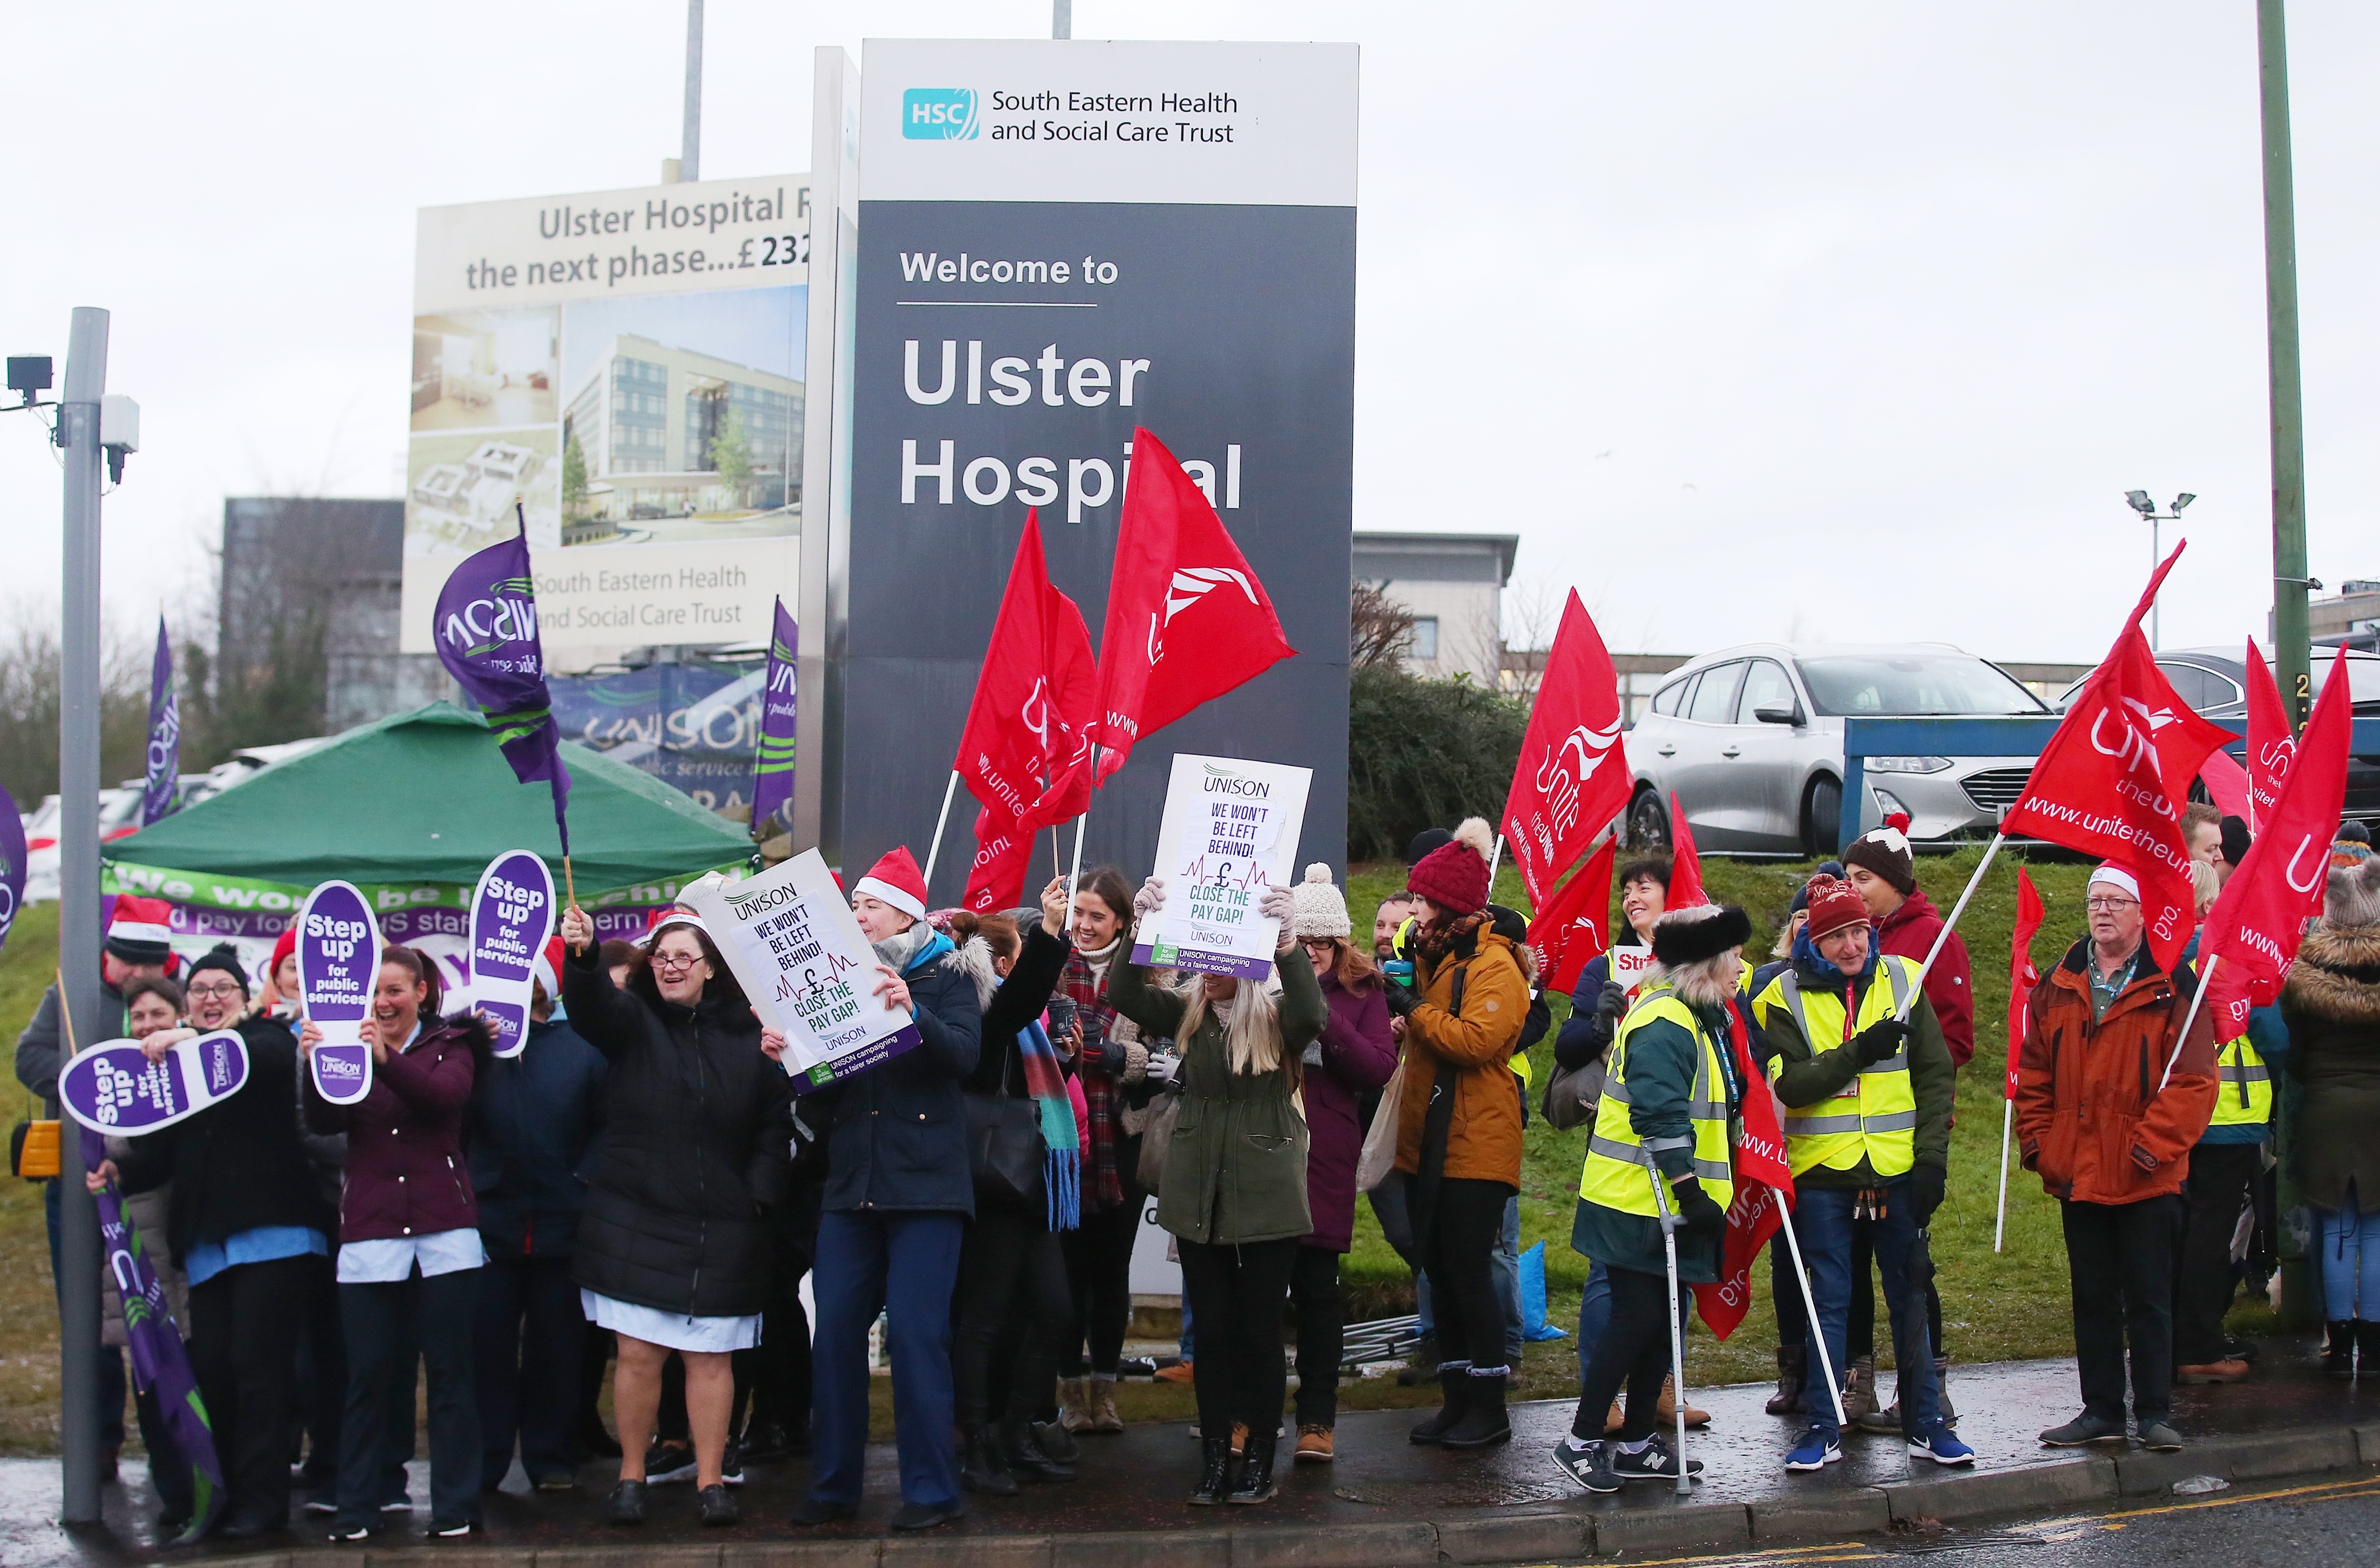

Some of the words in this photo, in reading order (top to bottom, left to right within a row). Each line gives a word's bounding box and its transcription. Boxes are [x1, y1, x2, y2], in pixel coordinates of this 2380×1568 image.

[912, 103, 964, 124] HSC
[992, 91, 1060, 111] South
[1068, 92, 1152, 112] Eastern
[1161, 93, 1238, 113] Health
[992, 120, 1036, 140] and
[1043, 121, 1108, 141] Social
[1116, 122, 1168, 142] Care
[1176, 122, 1234, 143] Trust
[539, 206, 634, 239] Ulster
[646, 187, 784, 234] Hospital
[467, 257, 518, 290] the
[527, 253, 598, 285] next
[899, 252, 1071, 284] Welcome
[1082, 254, 1119, 284] to
[902, 339, 1151, 407] Ulster
[900, 439, 1242, 523] Hospial
[534, 571, 591, 595] South
[599, 570, 673, 593] Eastern
[679, 565, 747, 589] Health
[577, 604, 634, 628] Social
[640, 604, 686, 627] Care
[691, 602, 742, 624] Trust
[1204, 777, 1270, 798] UNISON
[1211, 803, 1229, 818] WE
[1231, 804, 1269, 823] WON'T
[1213, 821, 1228, 836] BE
[1229, 823, 1258, 840] LEFT
[1208, 839, 1255, 858] BEHIND!
[1214, 862, 1232, 888] £
[113, 866, 194, 899] We
[377, 888, 441, 910] be
[486, 875, 544, 911] Step
[1189, 885, 1225, 903] CLOSE
[1227, 890, 1252, 906] THE
[497, 901, 529, 926] up
[734, 881, 797, 921] UNISON
[196, 910, 248, 935] pay
[417, 910, 470, 934] staf
[753, 920, 775, 940] WE
[777, 904, 810, 932] WON'T
[1191, 904, 1214, 920] PAY
[1215, 908, 1244, 925] GAP!
[306, 913, 367, 944] Step
[499, 925, 520, 940] for
[769, 937, 784, 955] BE
[786, 924, 815, 948] LEFT
[1191, 931, 1233, 945] UNISON
[321, 939, 355, 963] up
[476, 946, 532, 969] services
[485, 936, 528, 955] public
[777, 943, 823, 971] BEHIND!
[327, 964, 349, 977] for
[1177, 959, 1187, 967] for
[1193, 961, 1209, 970] fairer
[1210, 964, 1235, 975] society
[1179, 950, 1207, 960] UNISON
[1207, 954, 1251, 968] campaigning
[316, 978, 359, 992] public
[804, 968, 824, 995] £
[307, 991, 367, 1006] services
[794, 991, 830, 1019] CLOSE
[826, 980, 854, 1004] THE
[808, 1014, 830, 1033] PAY
[831, 999, 861, 1024] GAP!
[825, 1025, 867, 1051] UNISON
[830, 1055, 857, 1070] UNISON
[856, 1035, 898, 1059] campaigning
[848, 1061, 866, 1073] fairer
[866, 1049, 889, 1065] society
[322, 1061, 361, 1074] UNISON
[817, 1070, 831, 1079] public
[93, 1057, 119, 1125] Step
[113, 1069, 135, 1108] up
[137, 1074, 149, 1098] for
